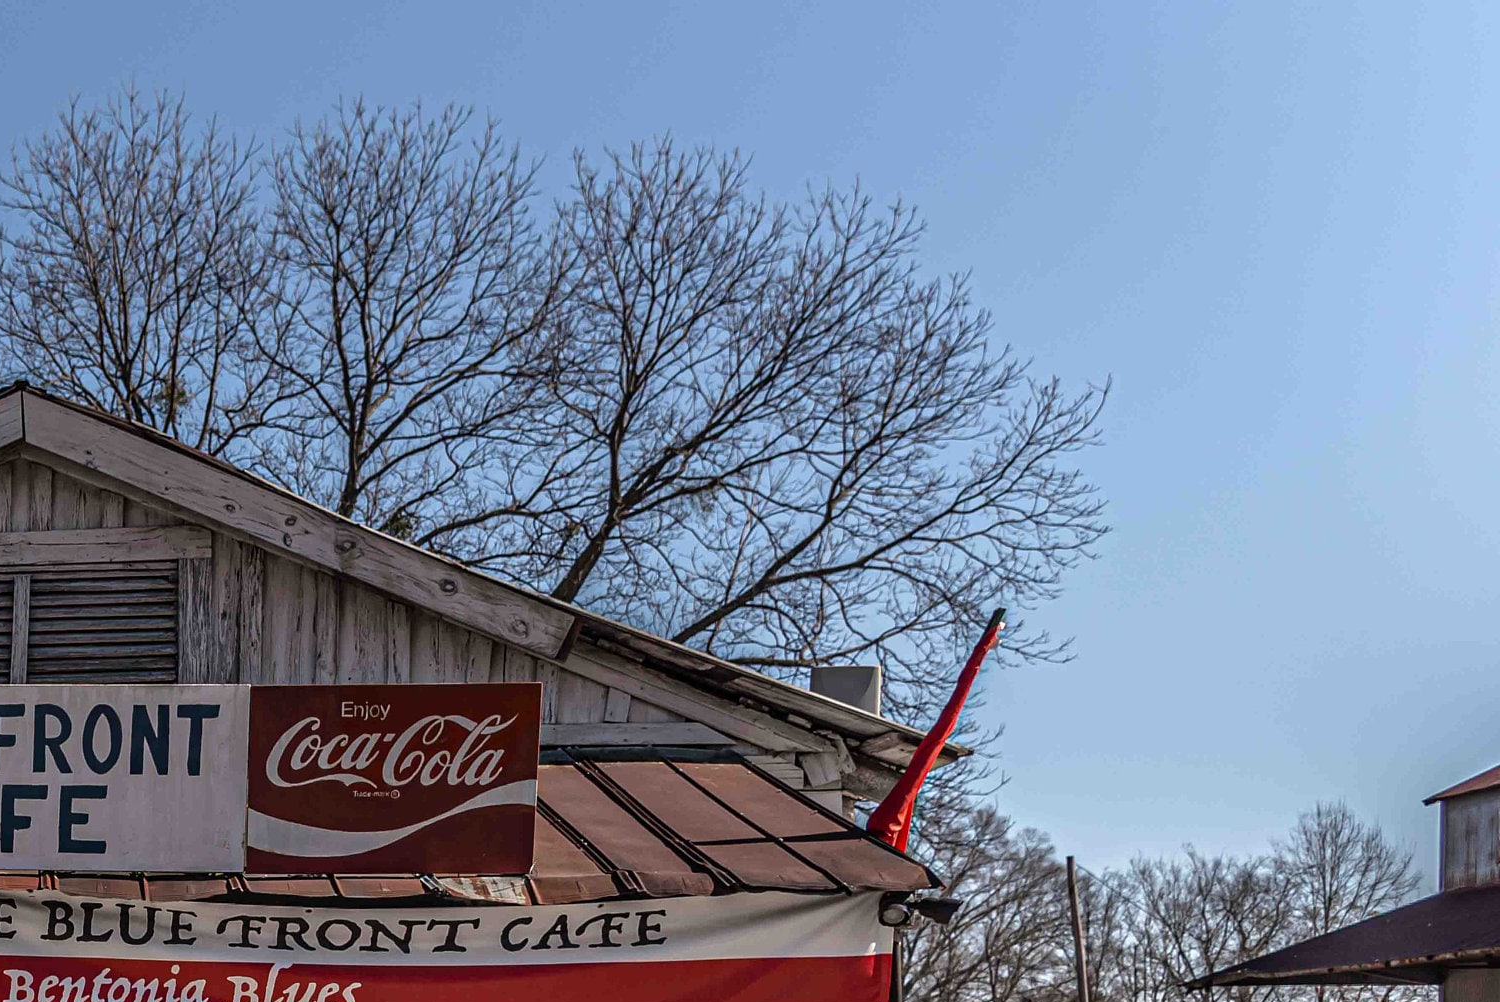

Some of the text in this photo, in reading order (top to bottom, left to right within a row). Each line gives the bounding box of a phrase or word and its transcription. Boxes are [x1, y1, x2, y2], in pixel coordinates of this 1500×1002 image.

[341, 701, 391, 721] Enjoy
[266, 714, 518, 789] Coca-Cola
[41, 900, 198, 946] BLUE
[217, 916, 481, 954] FRONT
[501, 910, 668, 953] CAFE
